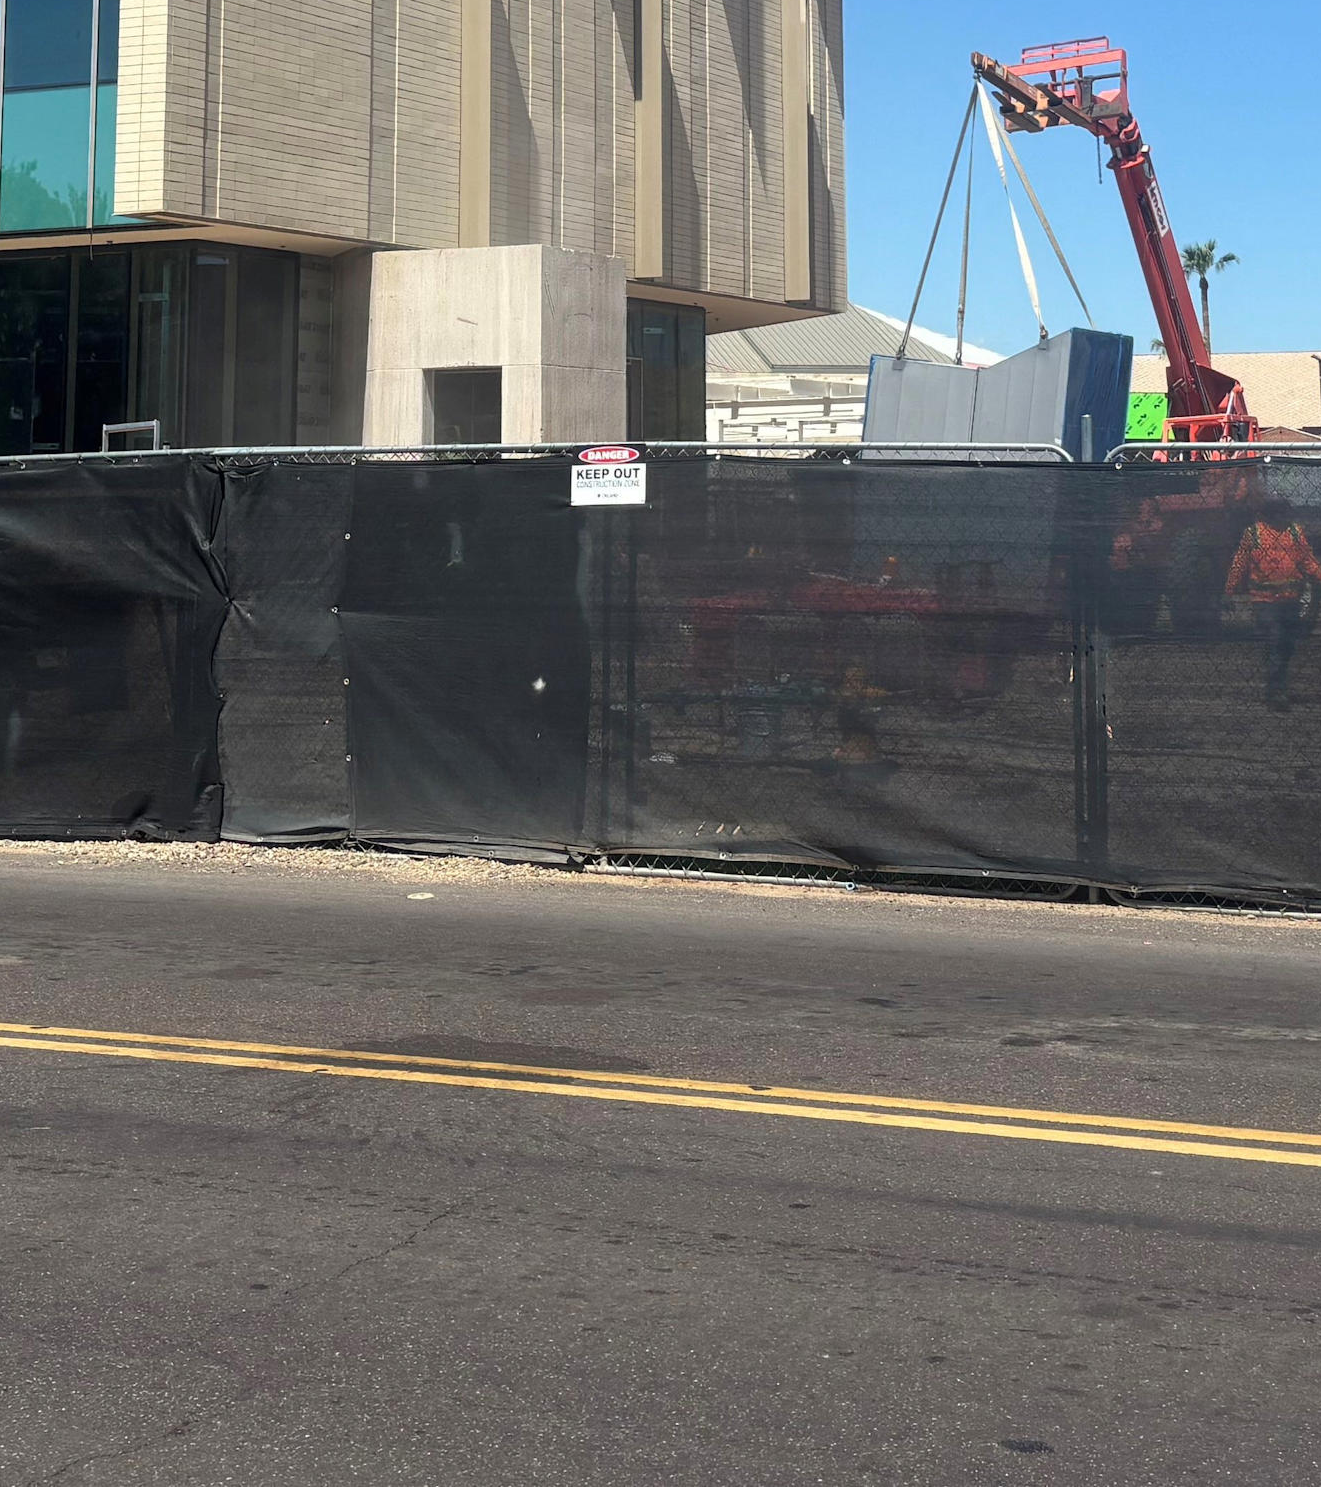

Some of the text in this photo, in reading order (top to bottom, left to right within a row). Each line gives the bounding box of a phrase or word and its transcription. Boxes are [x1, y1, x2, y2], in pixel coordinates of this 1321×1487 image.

[587, 451, 629, 460] DANGER
[576, 468, 640, 480] KEEP OUT
[576, 480, 622, 488] CONSTRUCTION
